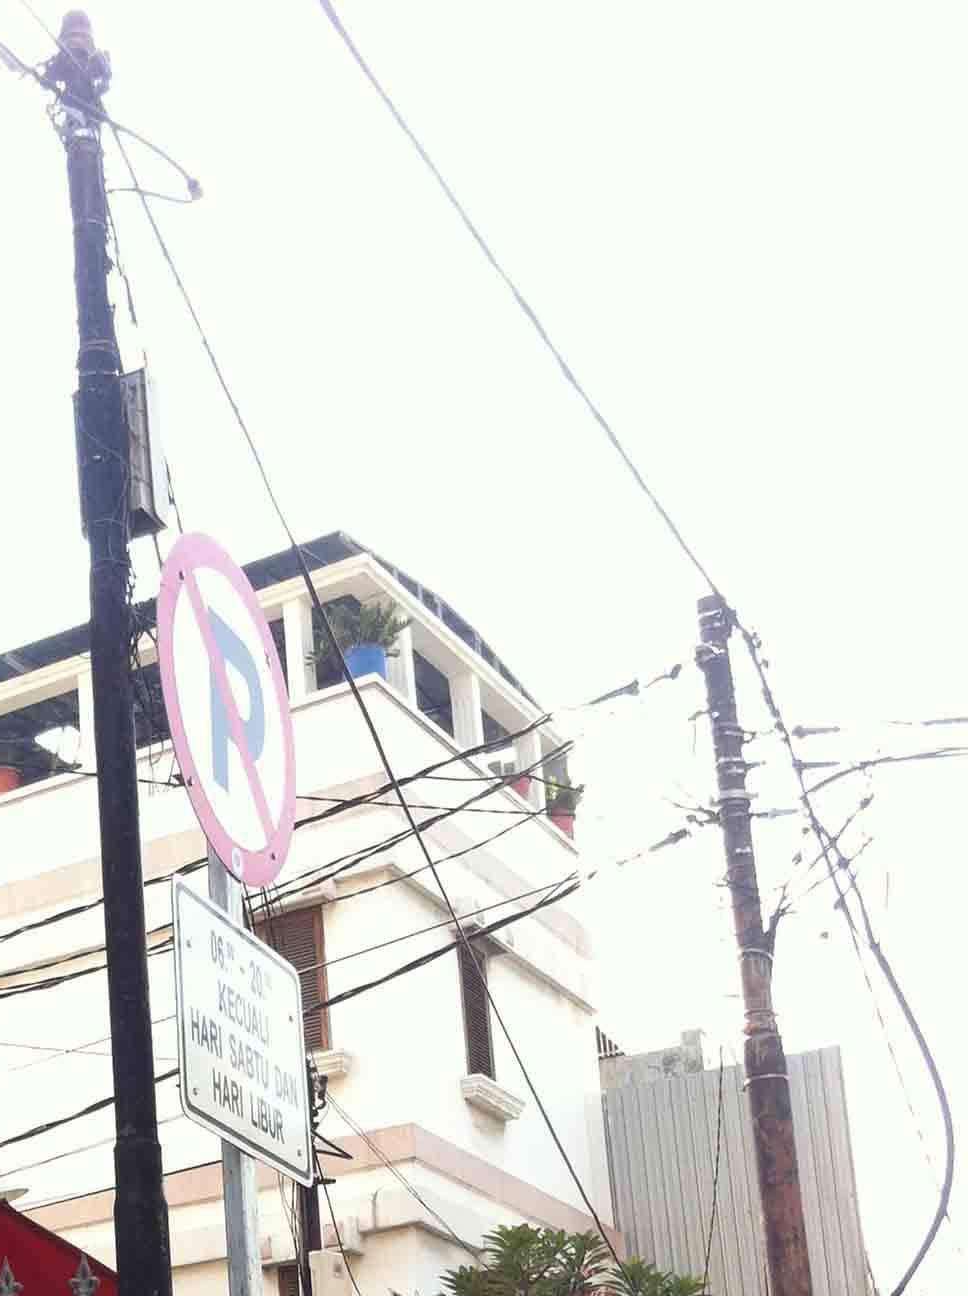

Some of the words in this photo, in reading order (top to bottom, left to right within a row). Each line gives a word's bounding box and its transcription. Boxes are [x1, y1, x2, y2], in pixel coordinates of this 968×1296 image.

[218, 980, 269, 1044] KECUALI
[190, 1007, 222, 1059] HARI
[229, 1034, 270, 1089] SABTU
[274, 1067, 298, 1109] DAN
[212, 1068, 244, 1120] HARI
[250, 1101, 285, 1144] LIBUR
